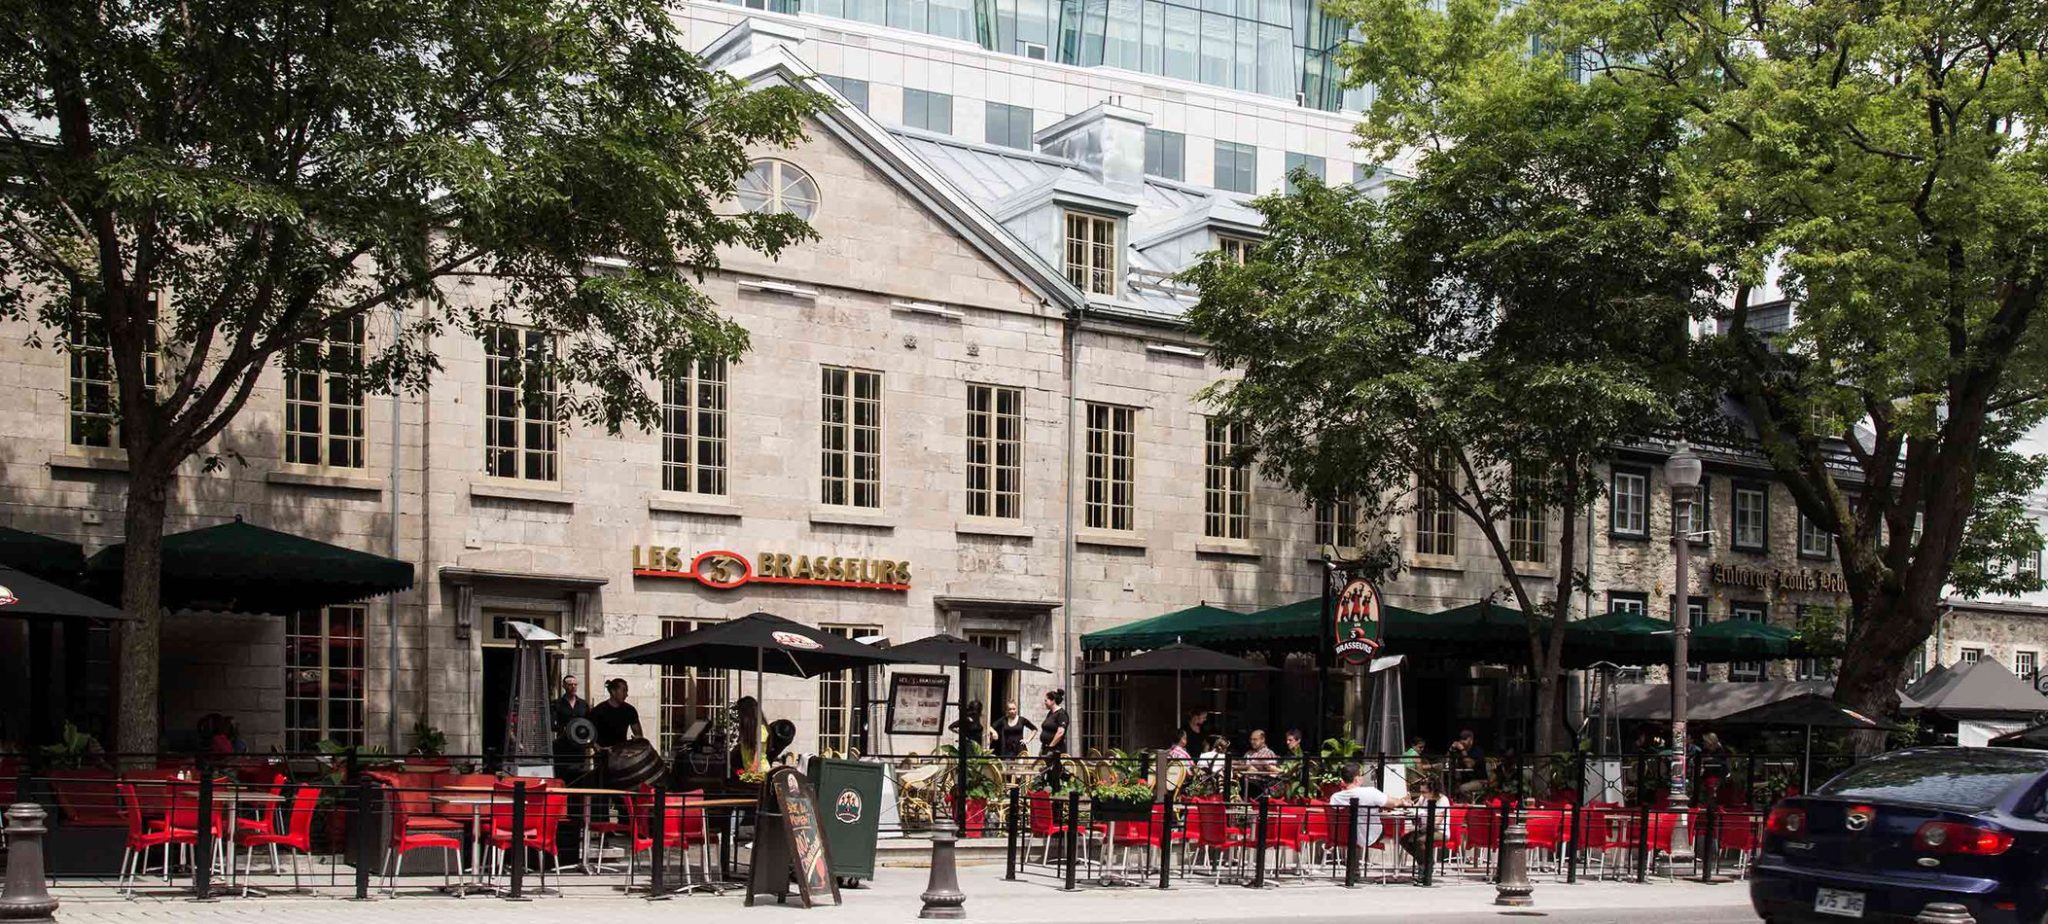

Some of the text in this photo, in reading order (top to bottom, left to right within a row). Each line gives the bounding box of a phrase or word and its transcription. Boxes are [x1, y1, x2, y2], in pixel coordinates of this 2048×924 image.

[632, 545, 912, 585] LES 3 BRASSEURS
[1712, 563, 1770, 590] Auberge
[1778, 569, 1815, 591] Louis
[1336, 642, 1372, 654] BRASSEURS
